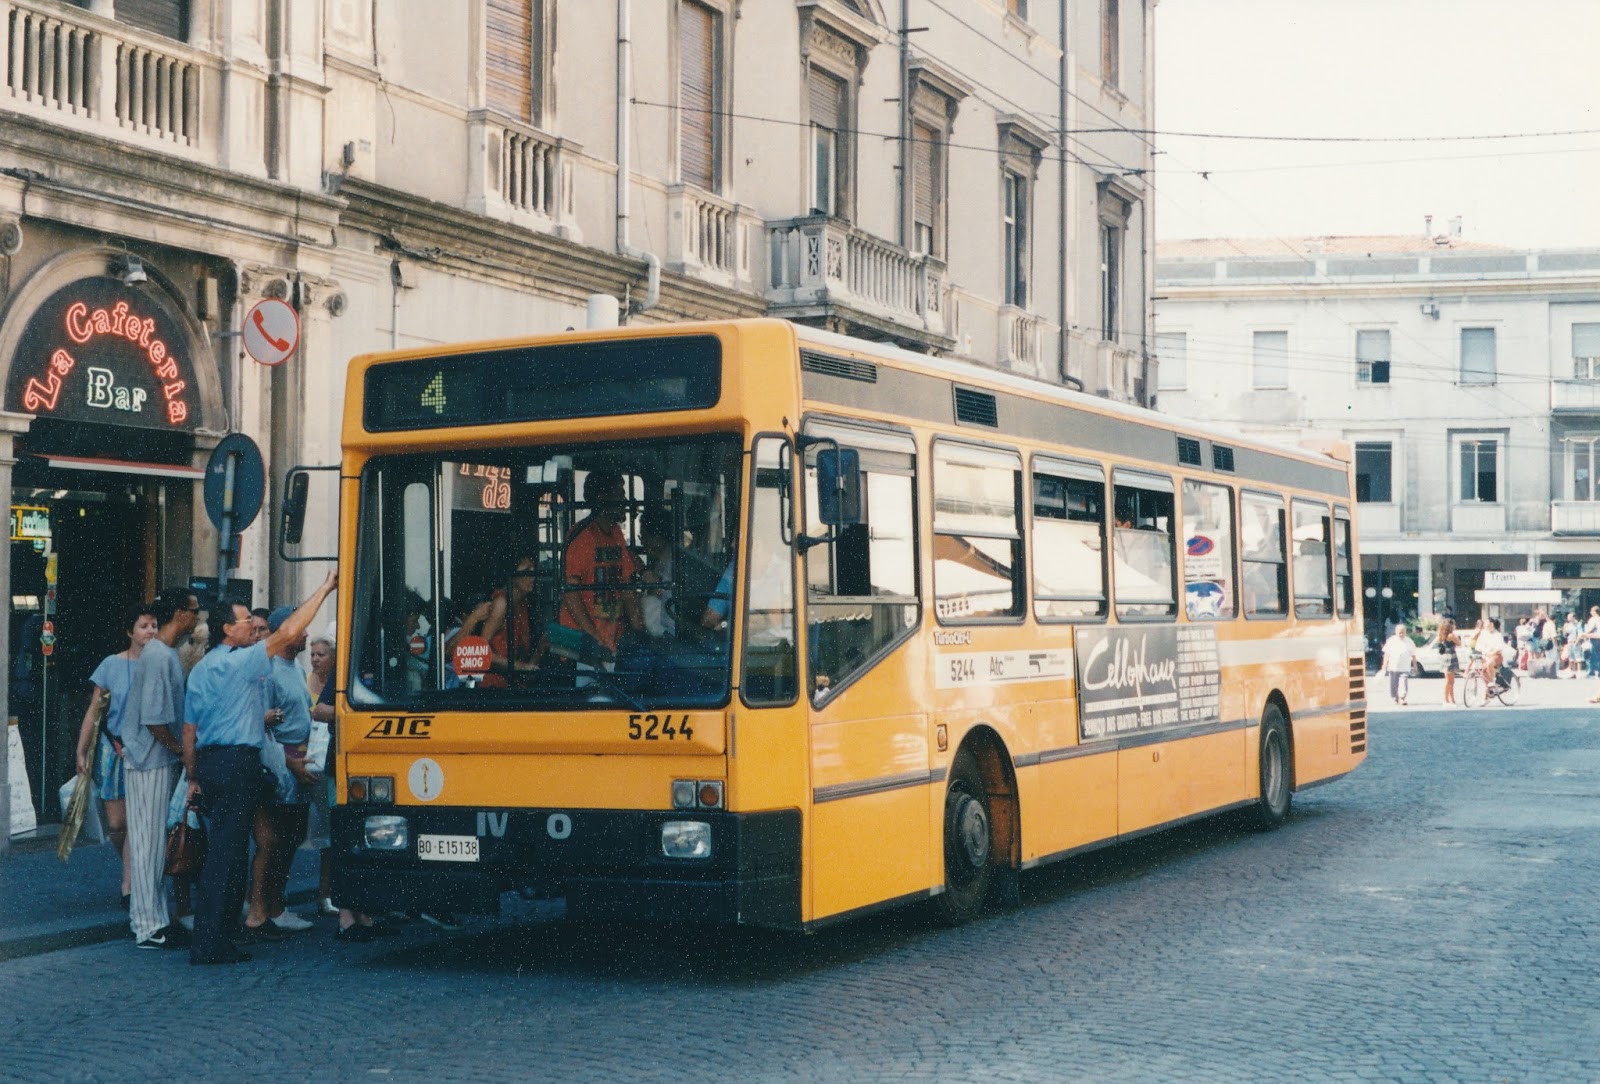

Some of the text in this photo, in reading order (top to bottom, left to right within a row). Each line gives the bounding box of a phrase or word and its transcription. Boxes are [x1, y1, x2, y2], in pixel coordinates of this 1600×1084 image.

[24, 301, 188, 424] La Cafeteria
[86, 366, 148, 412] Bar
[421, 371, 447, 414] 4
[1490, 572, 1516, 581] Tram
[456, 645, 489, 657] DOMANI
[460, 657, 484, 669] SMOG
[950, 656, 1004, 682] 5244 Atc
[364, 716, 436, 739] ATC
[628, 714, 694, 740] 5244
[438, 841, 478, 856] E15138
